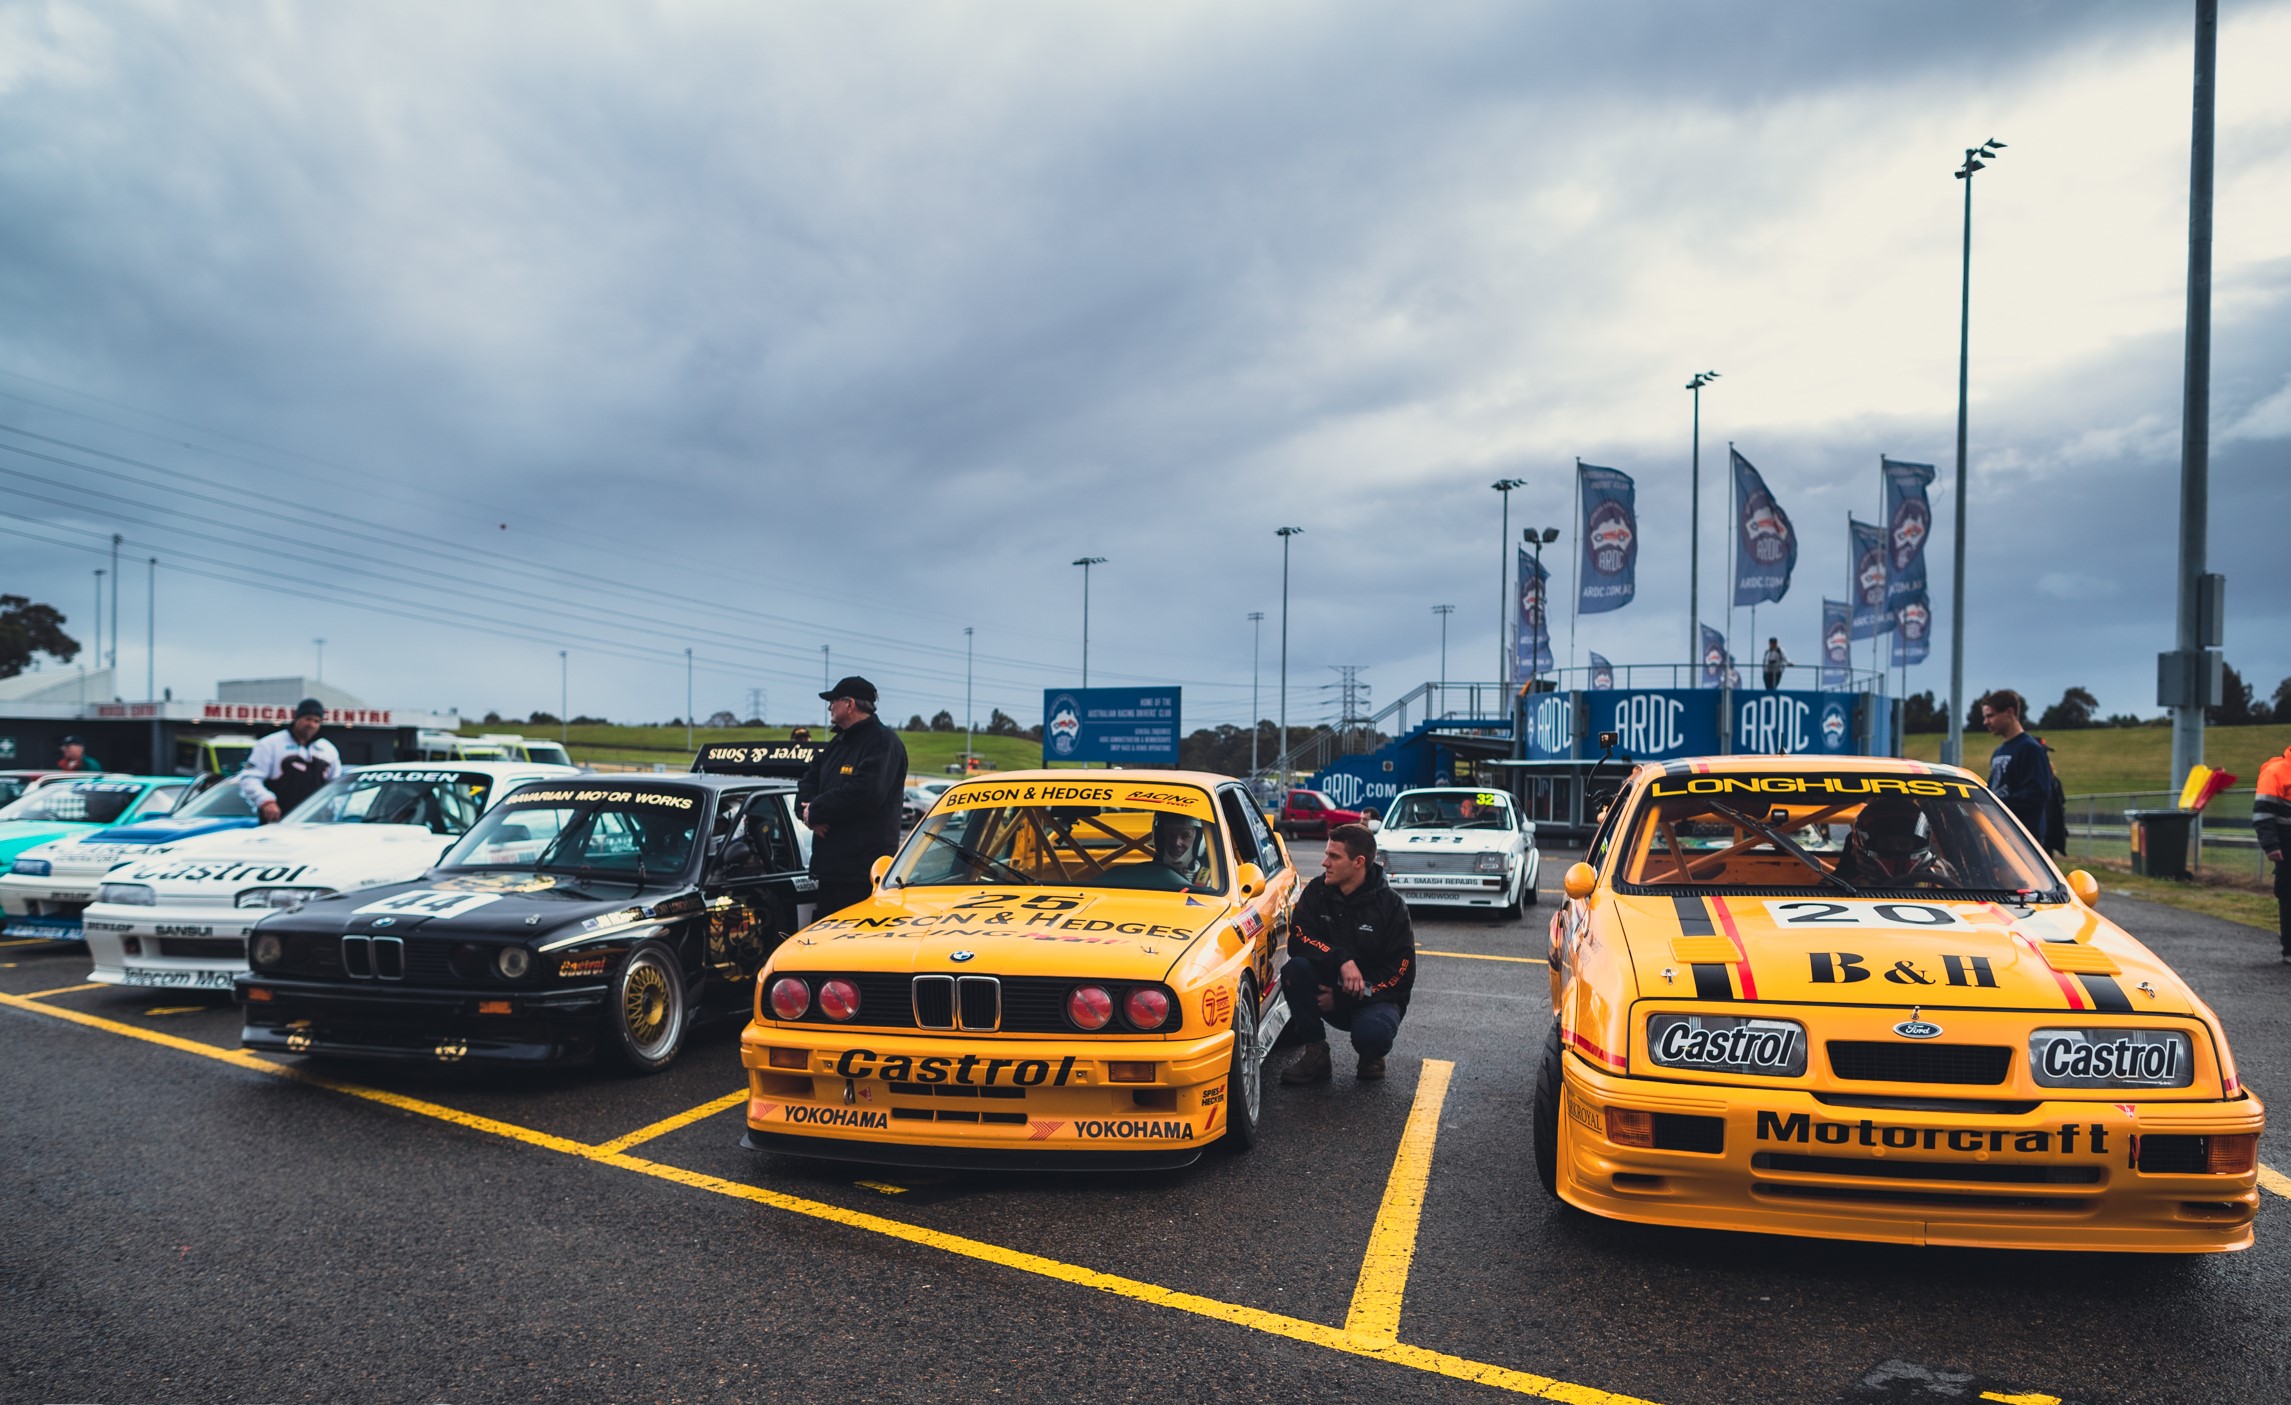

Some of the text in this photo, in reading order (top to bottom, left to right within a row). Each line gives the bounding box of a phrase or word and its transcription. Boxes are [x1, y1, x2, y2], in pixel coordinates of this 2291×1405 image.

[1598, 549, 1623, 571] ARDC
[1614, 694, 1684, 754] ARDC
[1740, 695, 1810, 754] ARDC
[708, 744, 824, 763] layer & Sons
[357, 771, 460, 782] HOLDEN
[946, 786, 1113, 807] BENSON & HEDGES
[1128, 791, 1199, 804] RACING
[1652, 778, 1978, 798] LONGHURST
[505, 791, 574, 805] BAVARIAN
[635, 793, 694, 809] WORKS
[1476, 794, 1495, 805] 32
[953, 893, 1085, 911] 25
[1406, 892, 1460, 900] COLLINGWOOD
[1778, 902, 1956, 925] 20
[87, 922, 213, 936] DUNLOP SANSUI
[806, 912, 970, 932] BENSON
[984, 911, 1014, 925] &
[1026, 911, 1193, 941] HEDGES
[832, 930, 1010, 940] RACING
[559, 957, 606, 977] Castrol
[1905, 1025, 1931, 1034] Ford
[1660, 1022, 1797, 1067] Castrol
[836, 1048, 1077, 1087] Castrol
[2042, 1036, 2179, 1079] Castrol
[784, 1105, 888, 1130] YOKOHAMA
[1074, 1121, 1194, 1140] YOKOHAMA
[1756, 1111, 2109, 1155] Motorcraft
